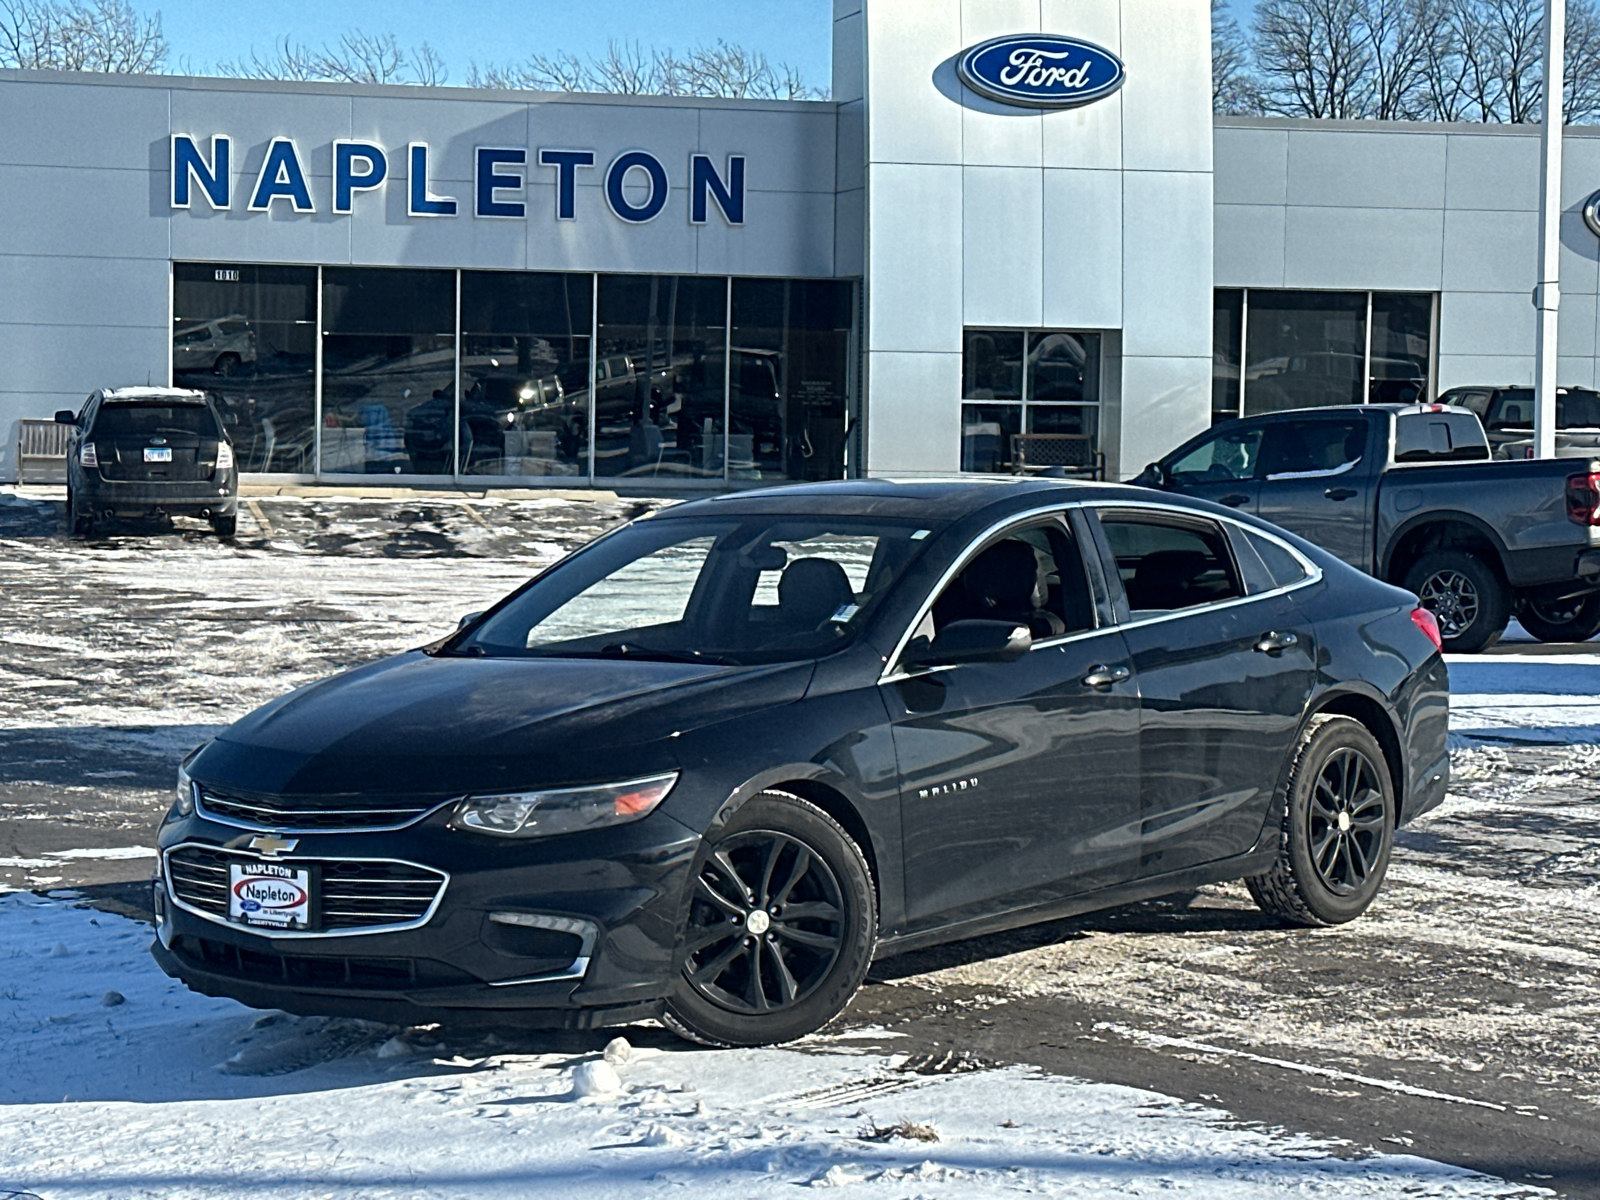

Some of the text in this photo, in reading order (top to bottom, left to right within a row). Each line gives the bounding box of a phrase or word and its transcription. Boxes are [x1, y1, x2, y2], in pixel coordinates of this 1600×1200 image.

[1000, 48, 1092, 88] Ford
[170, 132, 746, 226] NAPLETON
[215, 269, 239, 281] 1010
[919, 777, 978, 799] MALIBU
[245, 864, 292, 878] NAPLETON
[246, 883, 295, 903] Napleton
